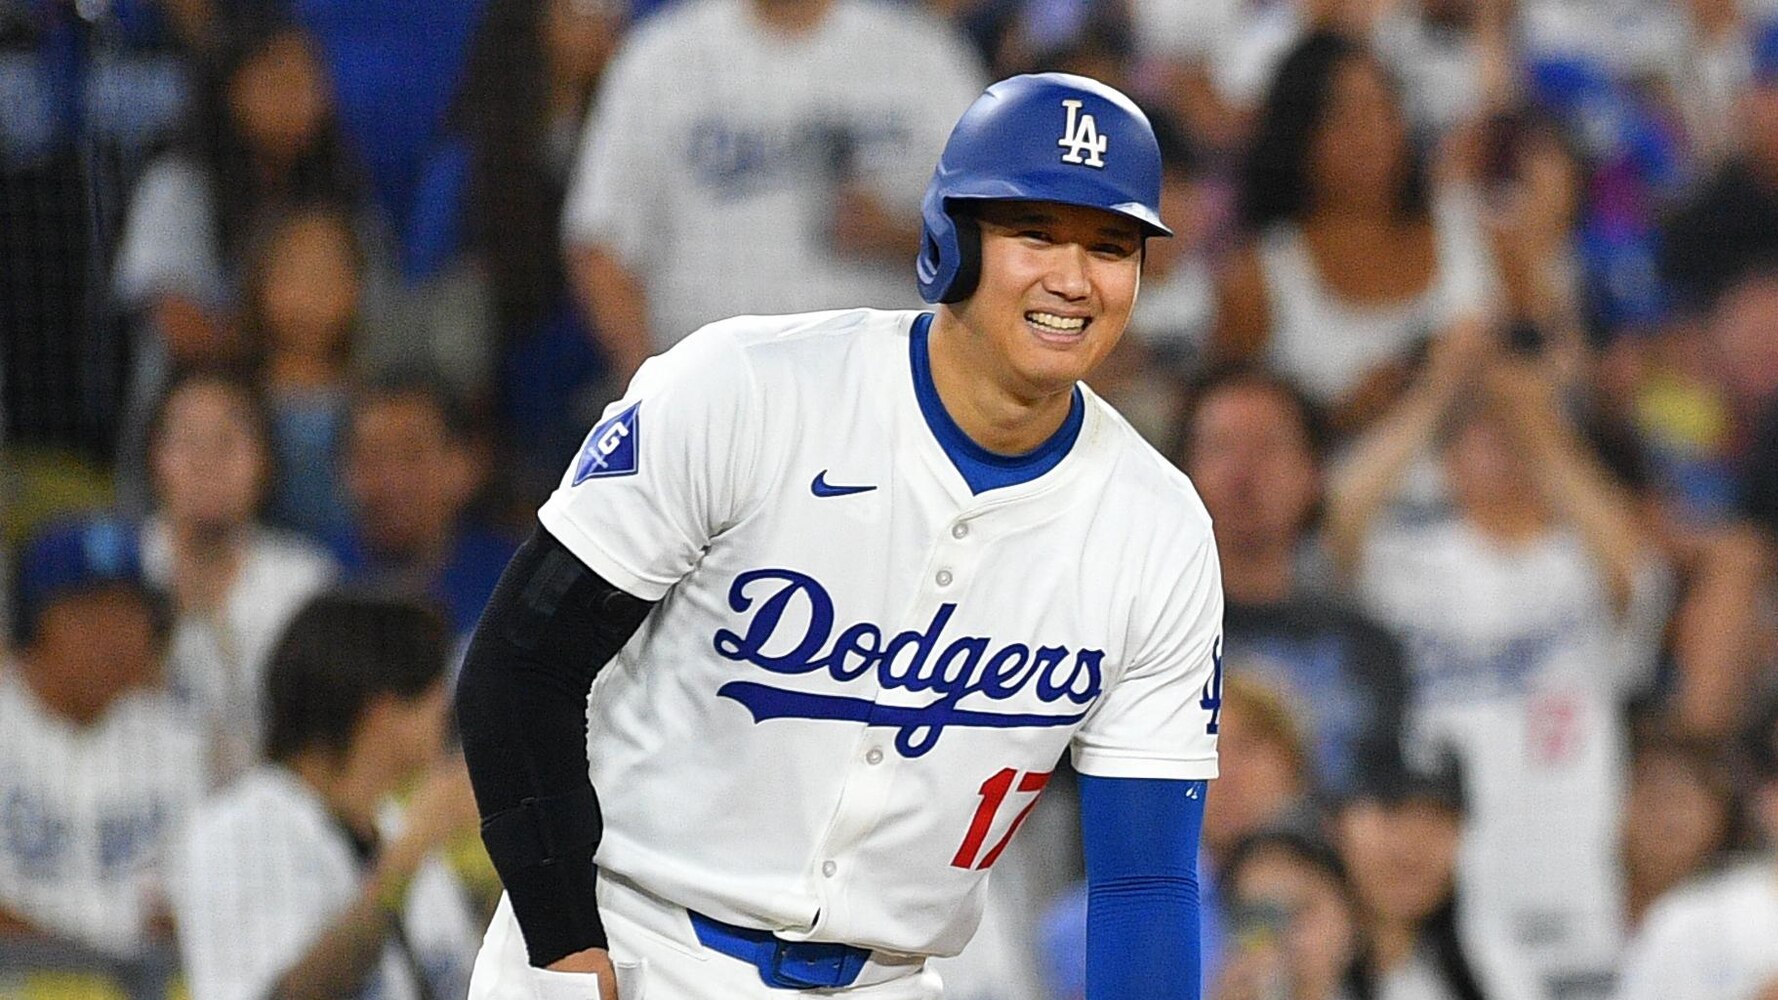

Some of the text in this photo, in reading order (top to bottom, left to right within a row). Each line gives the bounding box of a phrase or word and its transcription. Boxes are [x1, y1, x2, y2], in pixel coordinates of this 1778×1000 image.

[1059, 100, 1107, 167] LA
[713, 569, 1105, 757] Dodgers
[951, 767, 1053, 871] 17
